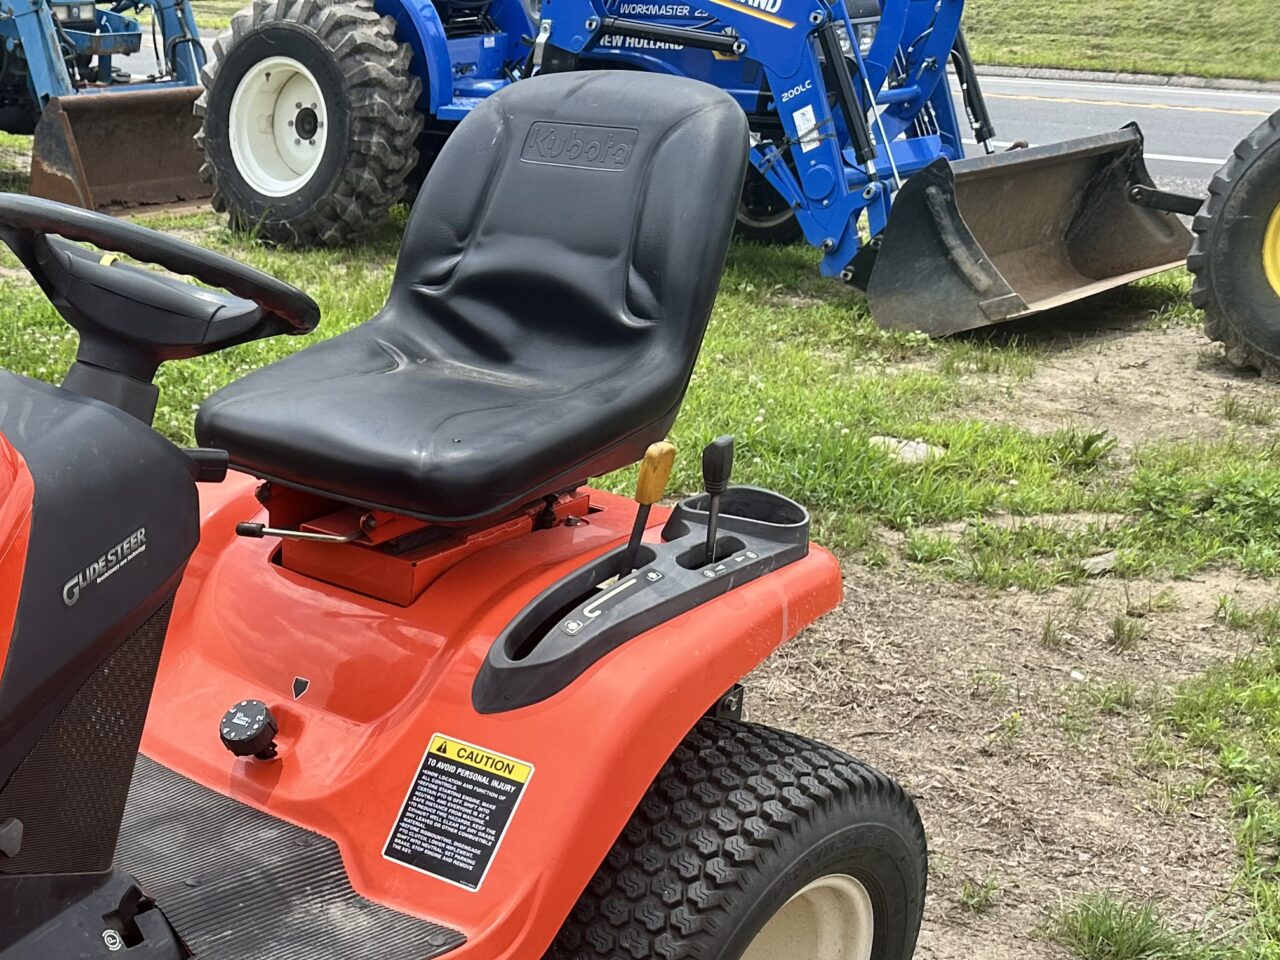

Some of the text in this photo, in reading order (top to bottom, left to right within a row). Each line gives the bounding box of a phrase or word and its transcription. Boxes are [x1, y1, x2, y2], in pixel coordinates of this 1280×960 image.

[620, 3, 689, 16] WORKMASTER
[781, 79, 813, 102] 200LC
[527, 126, 630, 166] Kubota
[62, 527, 148, 607] GLIDE STEER
[428, 758, 516, 793] TO AVOID PERSONAL INJURY
[457, 748, 514, 774] CAUTION
